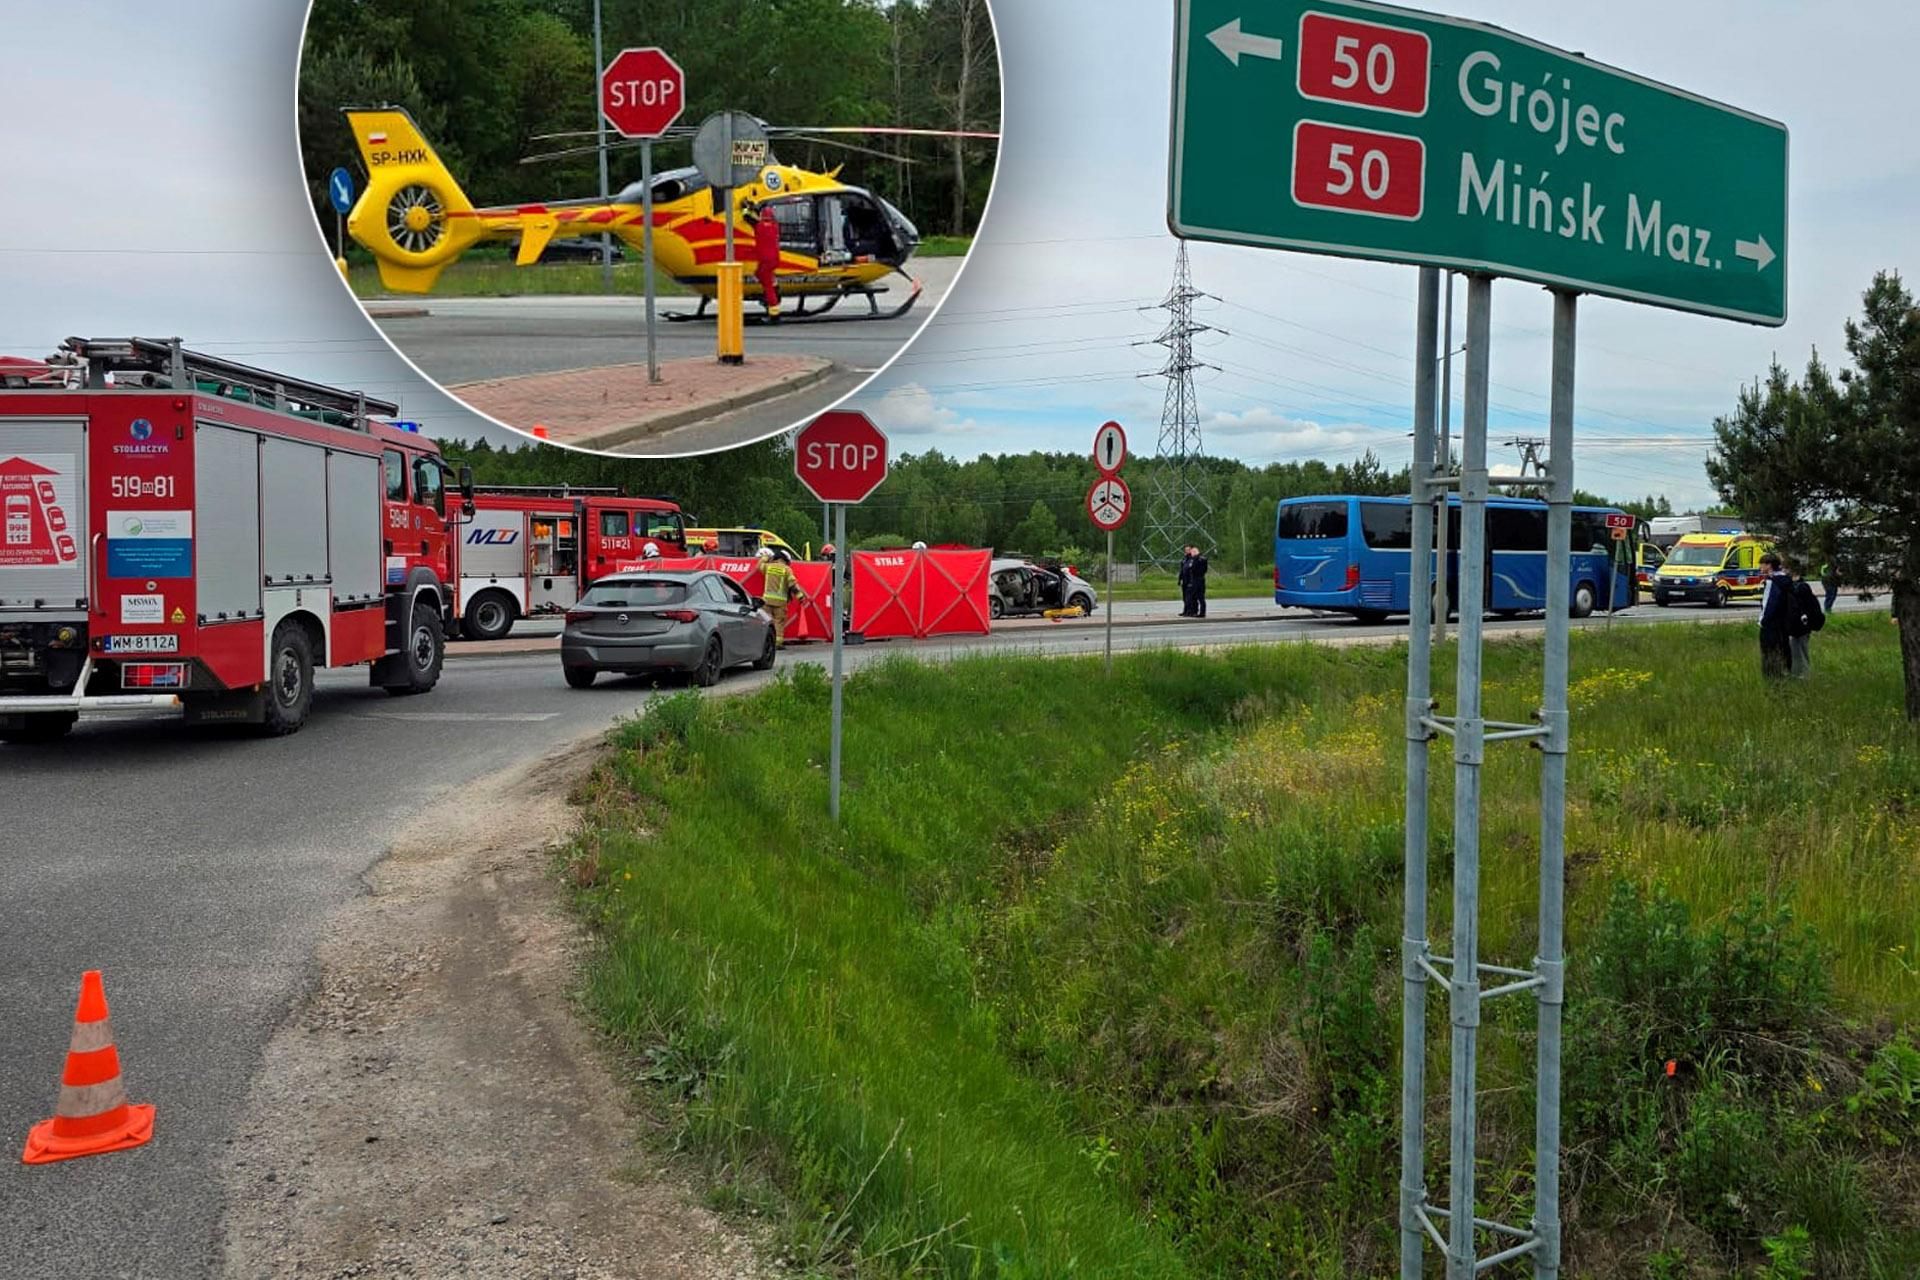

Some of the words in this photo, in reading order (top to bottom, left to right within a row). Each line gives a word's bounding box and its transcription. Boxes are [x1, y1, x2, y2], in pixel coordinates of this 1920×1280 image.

[1331, 35, 1395, 95] 50
[610, 79, 675, 107] STOP
[1457, 50, 1626, 156] Grójec
[371, 148, 428, 166] SP-HXK
[1326, 142, 1390, 200] 50
[1457, 151, 1606, 244] Mińsk
[1625, 192, 1722, 270] Maz.
[112, 445, 169, 454] STOLARCZYK
[805, 441, 878, 471] STOP
[1612, 516, 1628, 527] 50
[9, 534, 28, 542] 112
[113, 636, 131, 648] WM
[135, 636, 176, 649] 8112A
